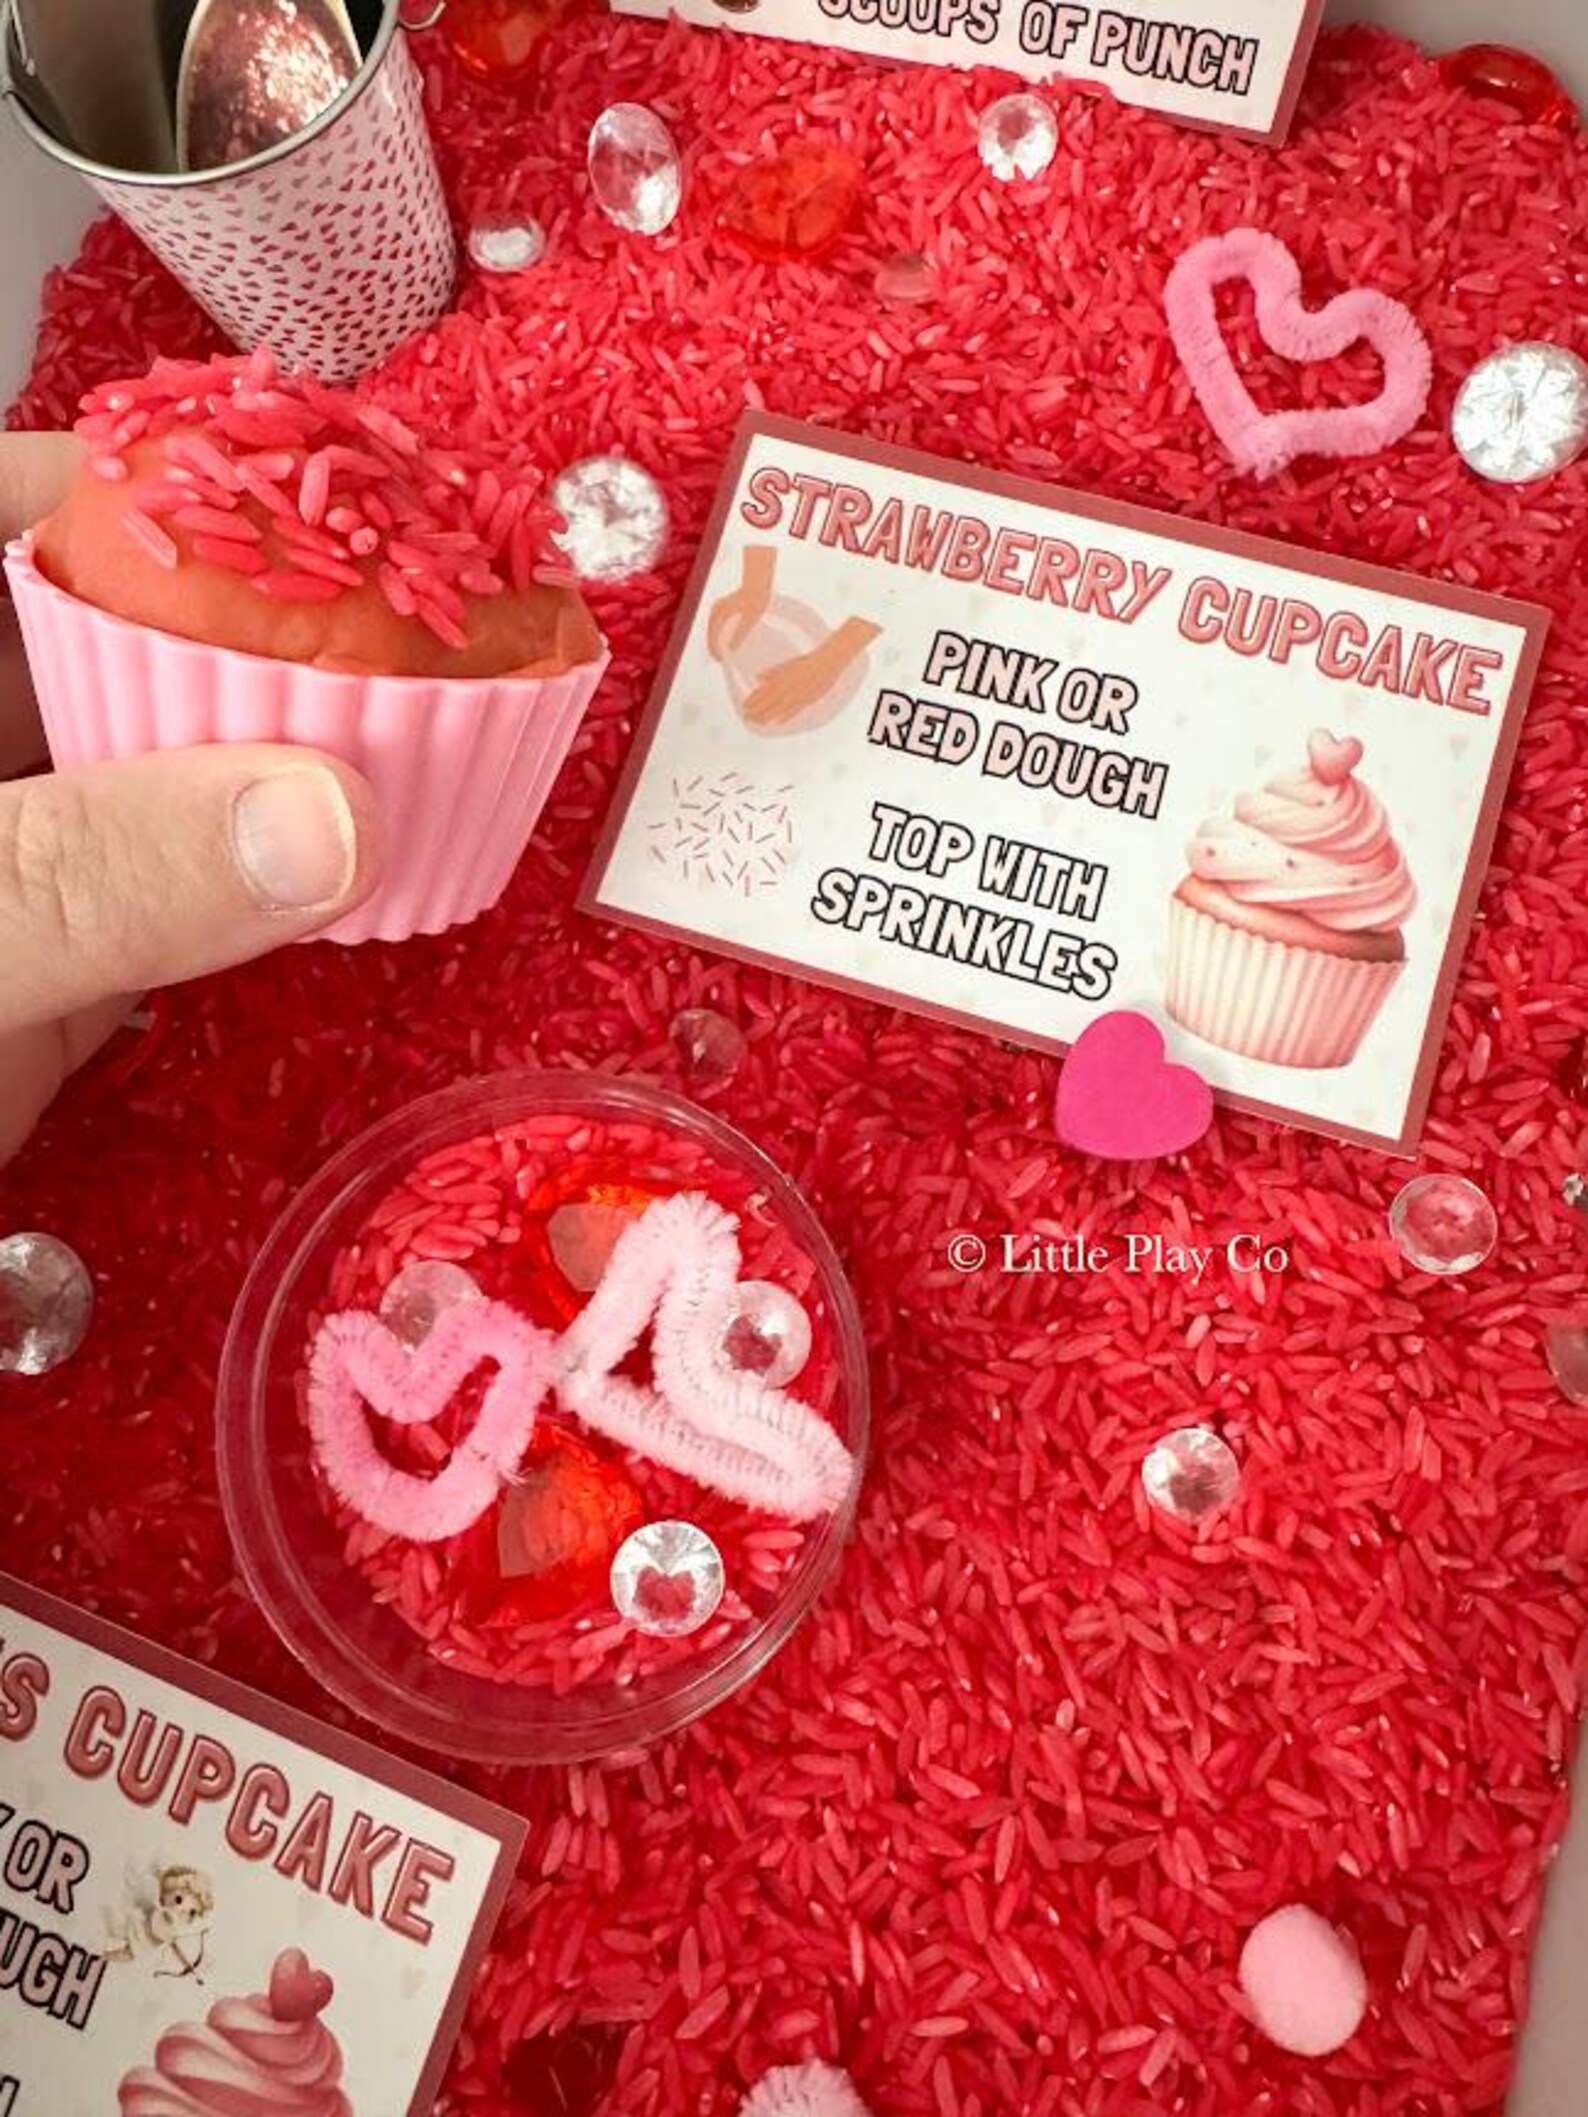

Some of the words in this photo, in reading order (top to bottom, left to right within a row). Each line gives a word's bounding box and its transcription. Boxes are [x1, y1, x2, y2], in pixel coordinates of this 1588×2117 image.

[1019, 0, 1085, 60] OF
[1091, 12, 1259, 96] PUNCH
[741, 467, 1171, 625] STRAWBERRY
[1178, 576, 1504, 715] CUPCAKE
[923, 630, 1058, 713] PINK
[1057, 667, 1139, 734] OR
[868, 689, 980, 765] RED
[981, 721, 1169, 819] DOUGH
[869, 802, 975, 878] TOP
[979, 835, 1109, 922] WITH
[811, 867, 1118, 1001] SPRINKLES
[4, 1820, 90, 1914] OR
[63, 1684, 455, 1947] CUPCAKE
